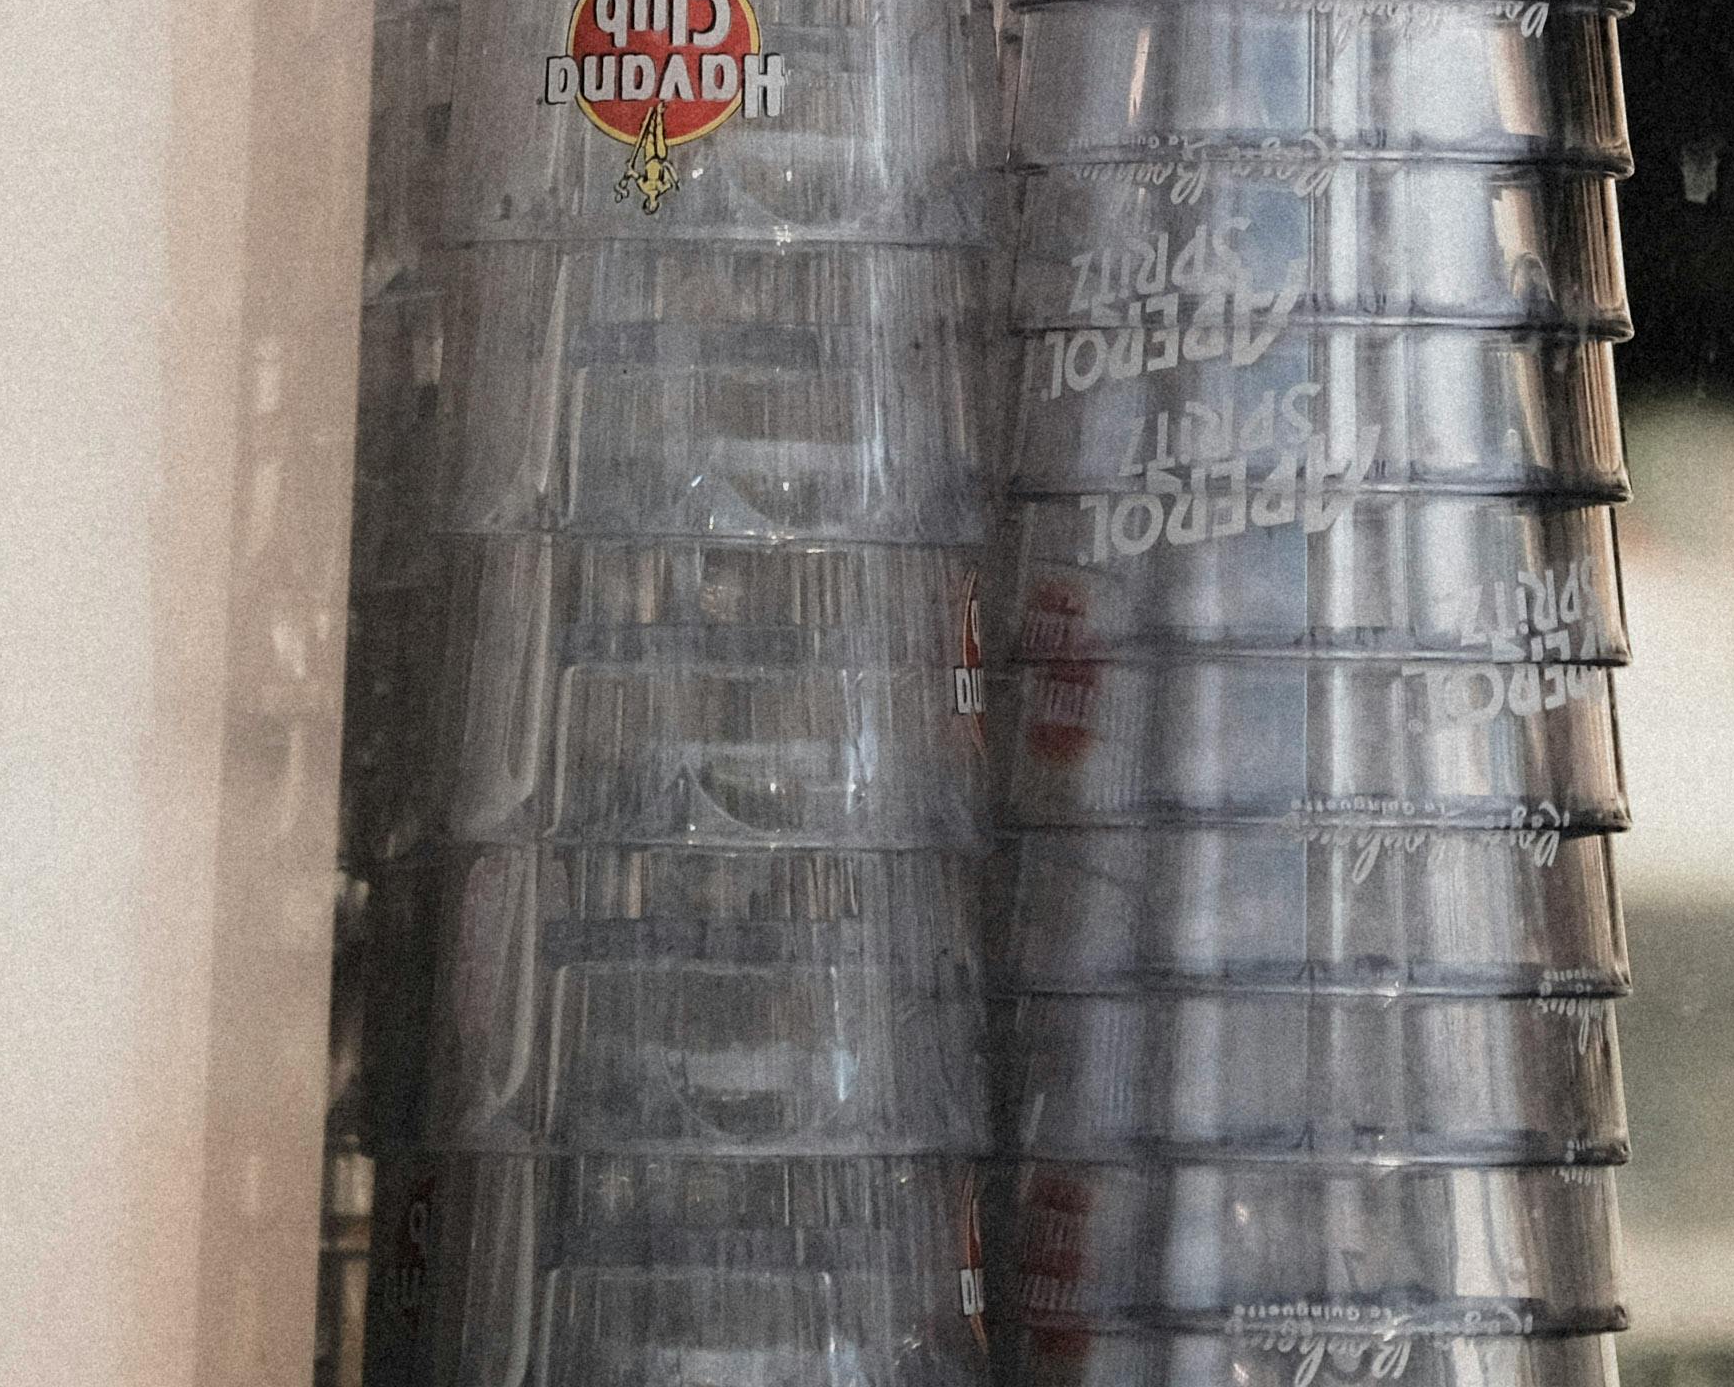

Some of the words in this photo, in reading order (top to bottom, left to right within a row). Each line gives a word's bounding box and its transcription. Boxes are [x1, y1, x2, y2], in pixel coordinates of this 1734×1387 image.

[545, 53, 785, 118] Havana
[1043, 257, 1309, 399] APEROL
[1077, 424, 1381, 565] APEROL
